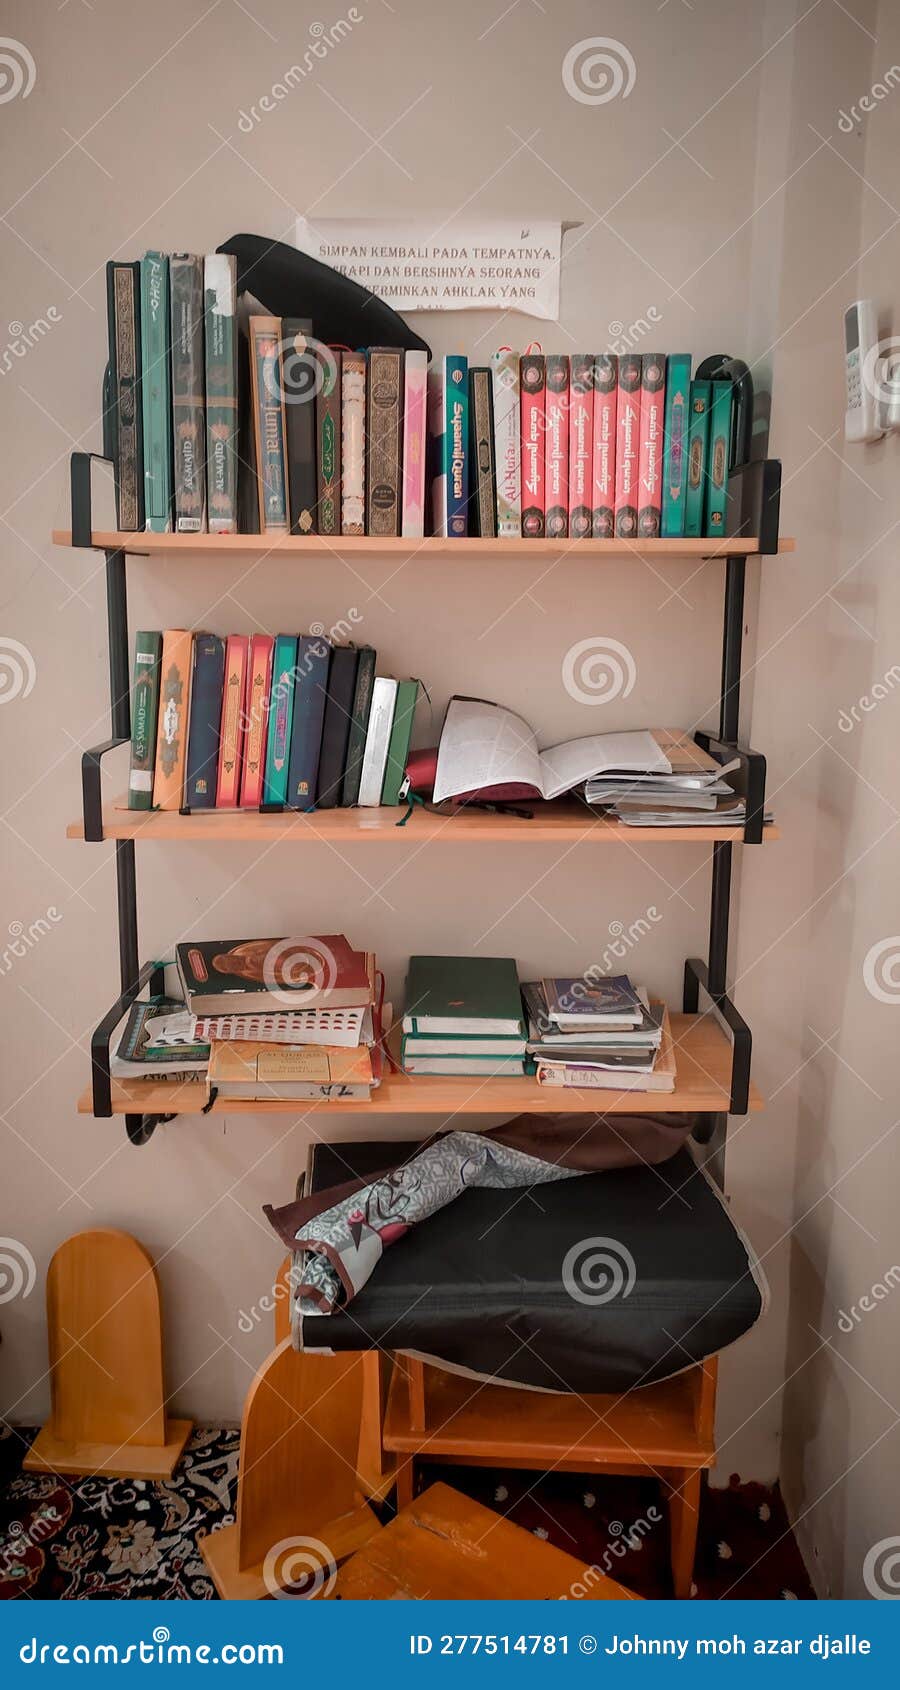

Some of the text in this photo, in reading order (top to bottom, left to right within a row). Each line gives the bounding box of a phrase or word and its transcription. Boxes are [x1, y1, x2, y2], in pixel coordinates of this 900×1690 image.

[319, 246, 367, 257] SIMPAN
[371, 247, 428, 258] KEMBALI
[433, 248, 468, 258] PADA
[374, 267, 400, 277] DAN
[404, 265, 476, 278] BERSIHNYA
[480, 267, 540, 278] SEORANG
[442, 286, 496, 297] AHKLAK
[500, 285, 536, 298] YANG
